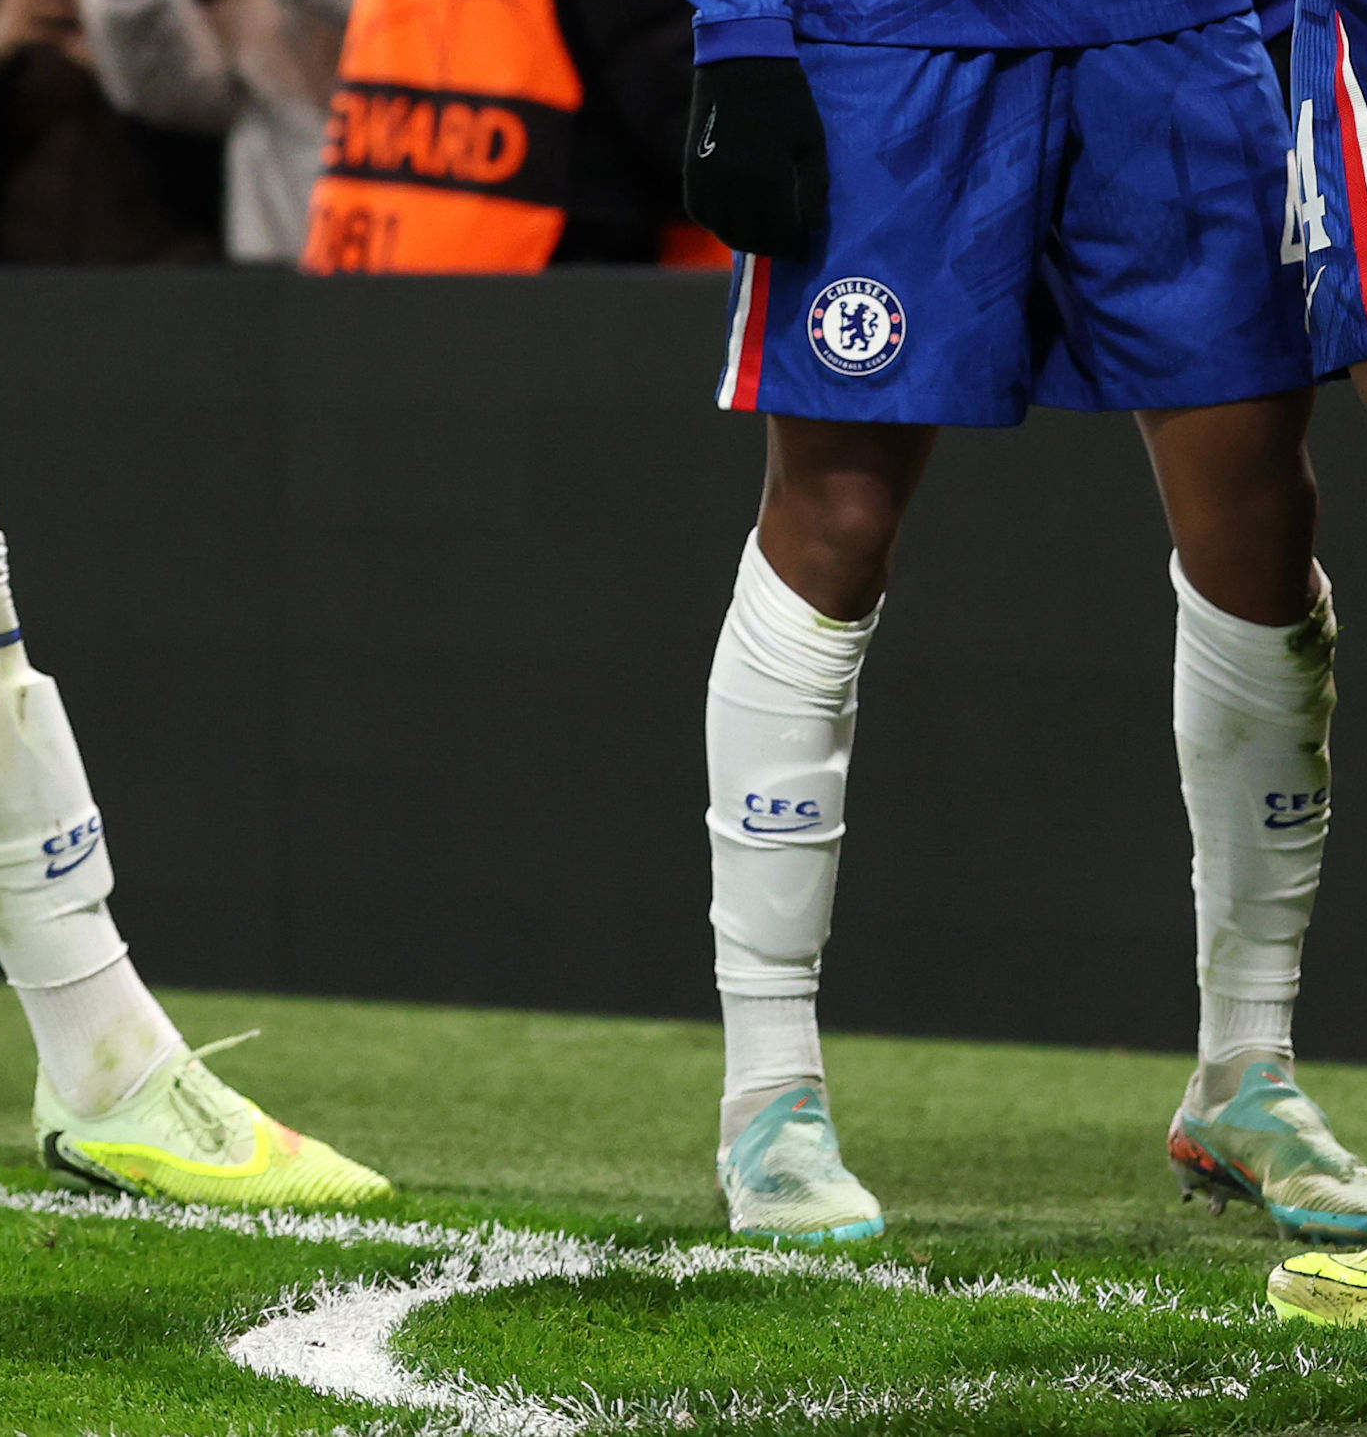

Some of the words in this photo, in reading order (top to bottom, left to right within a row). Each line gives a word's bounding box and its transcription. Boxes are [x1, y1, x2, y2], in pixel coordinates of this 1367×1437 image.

[826, 282, 889, 305] CHELSEA
[745, 793, 821, 818] CFC
[1265, 787, 1327, 813] CFC
[42, 816, 100, 856] CFC
